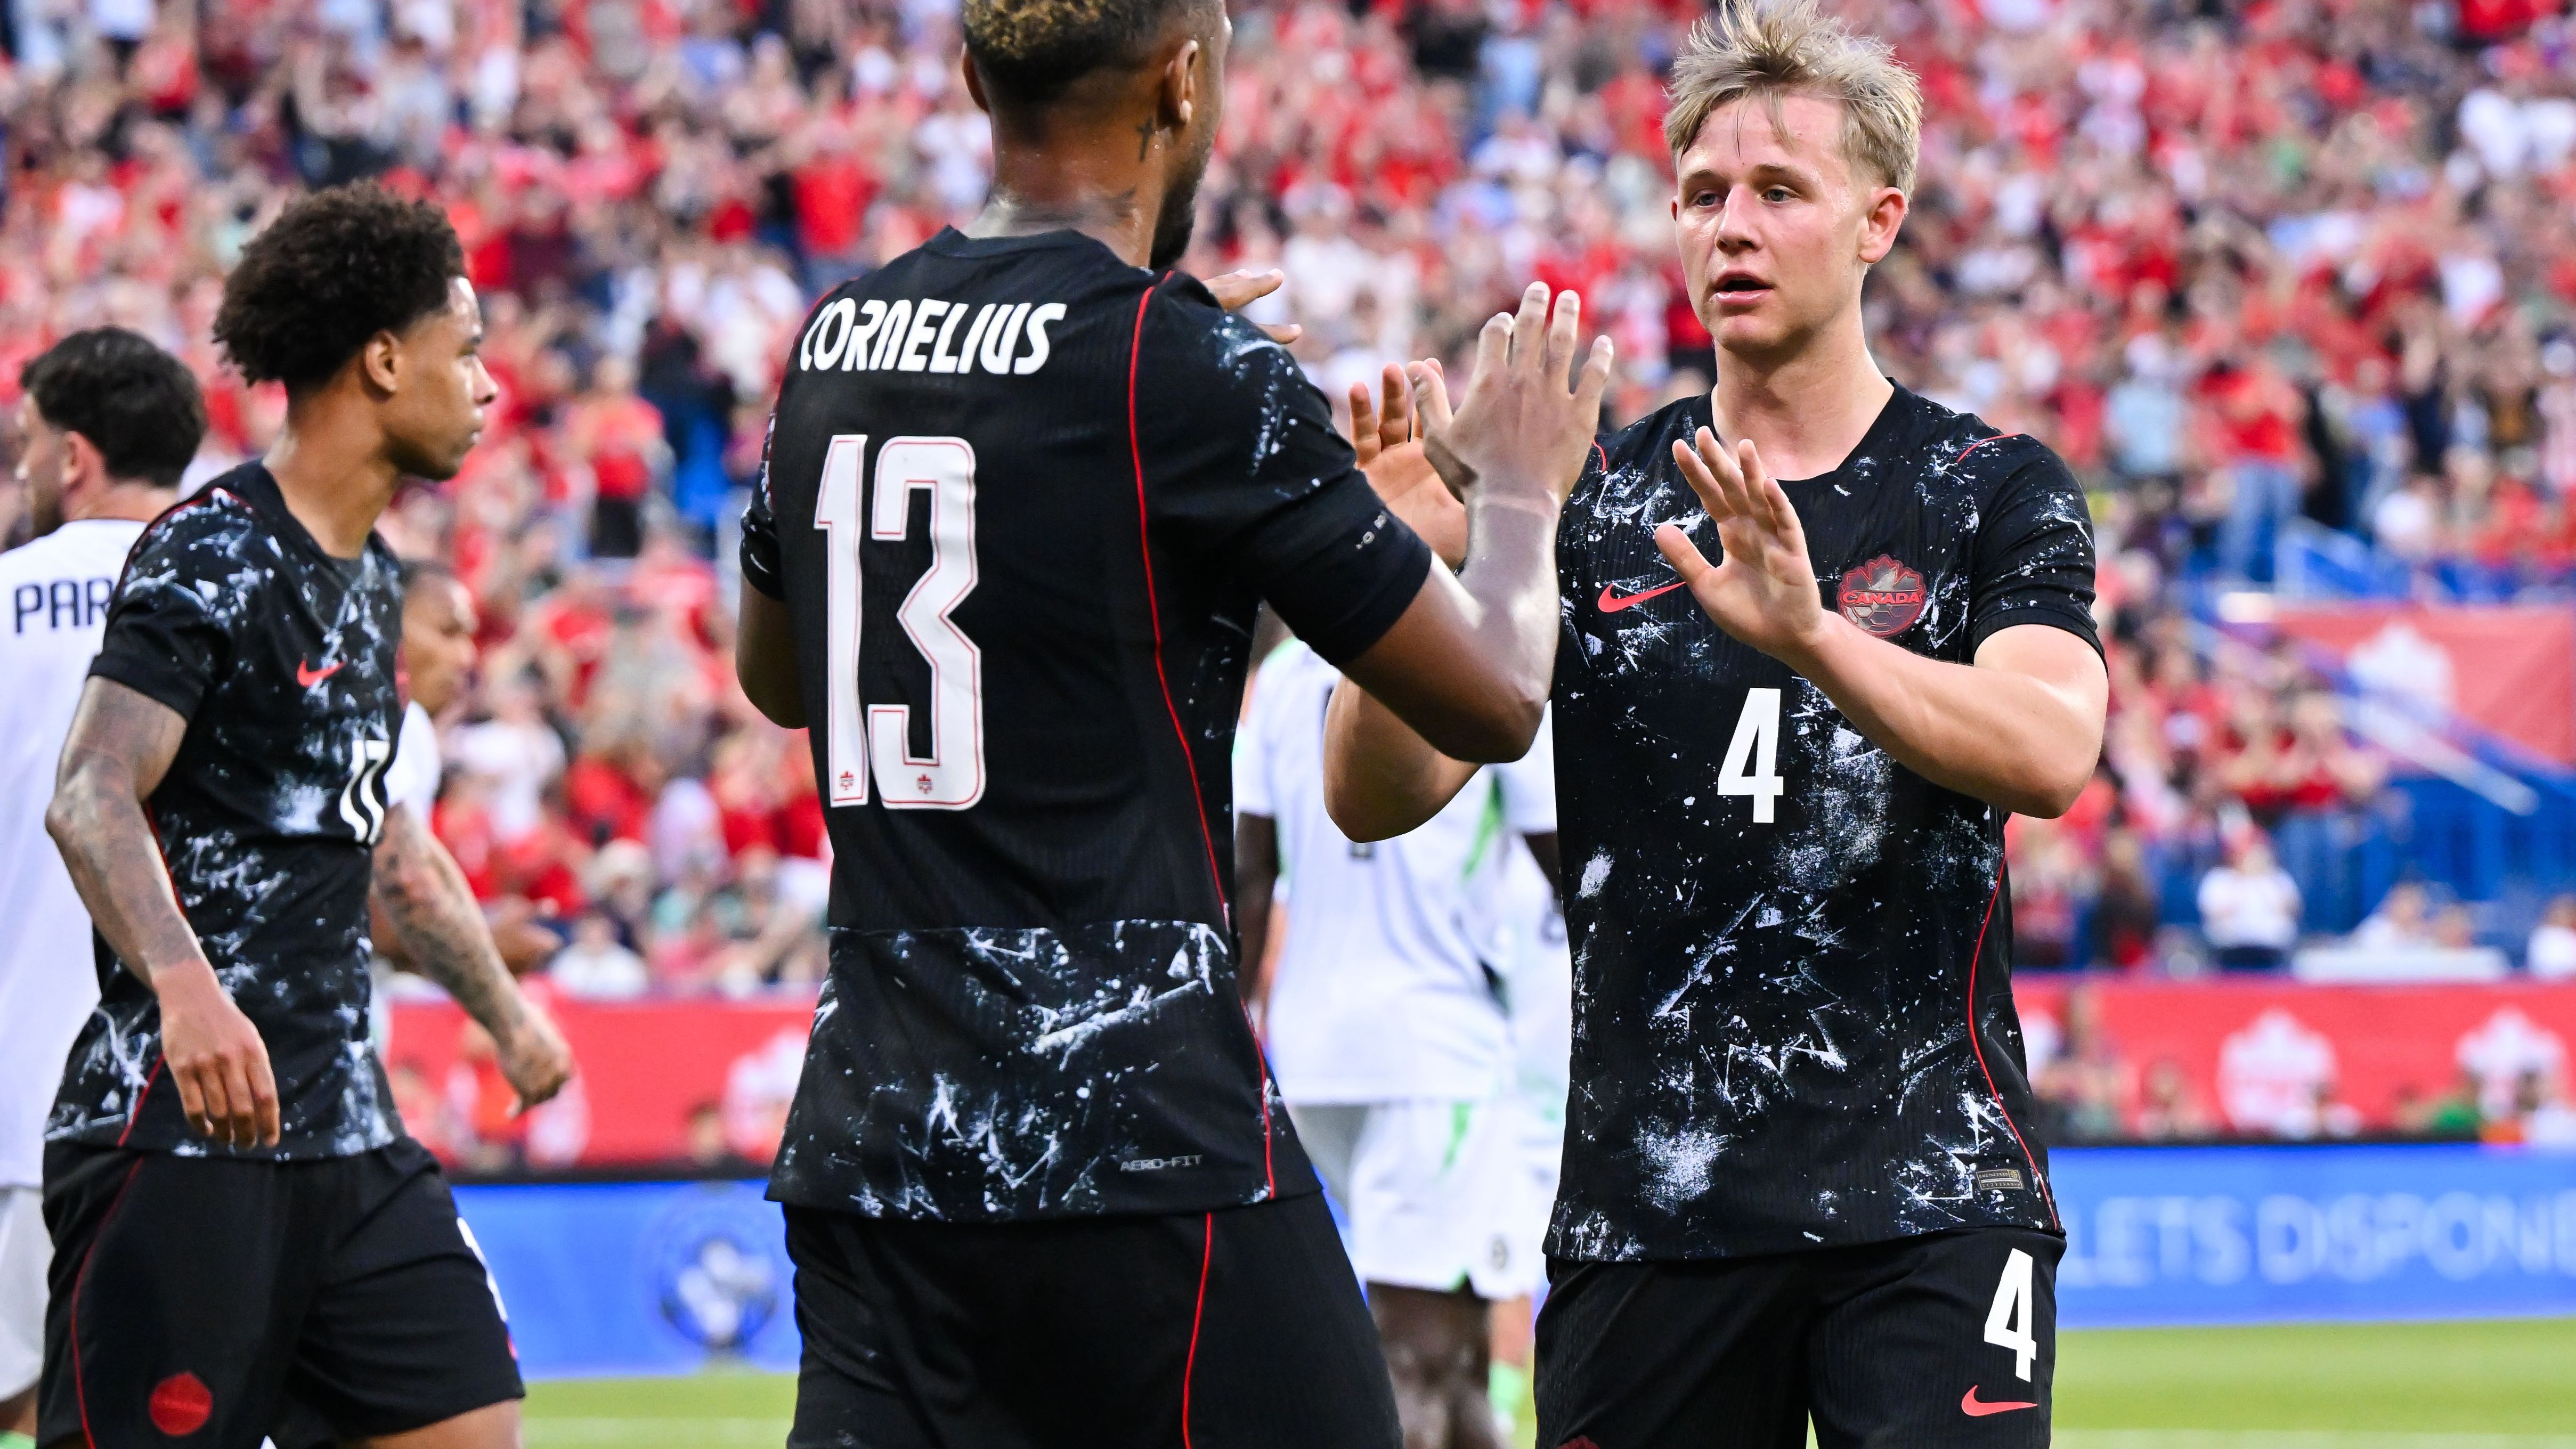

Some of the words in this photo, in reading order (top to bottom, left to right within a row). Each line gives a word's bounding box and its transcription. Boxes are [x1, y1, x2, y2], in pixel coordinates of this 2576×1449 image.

[800, 297, 1067, 375] CORNELIUS
[814, 434, 986, 811] 13
[1842, 591, 1920, 604] CANADA
[1717, 687, 1784, 823] 4
[1984, 1248, 2037, 1382] 4
